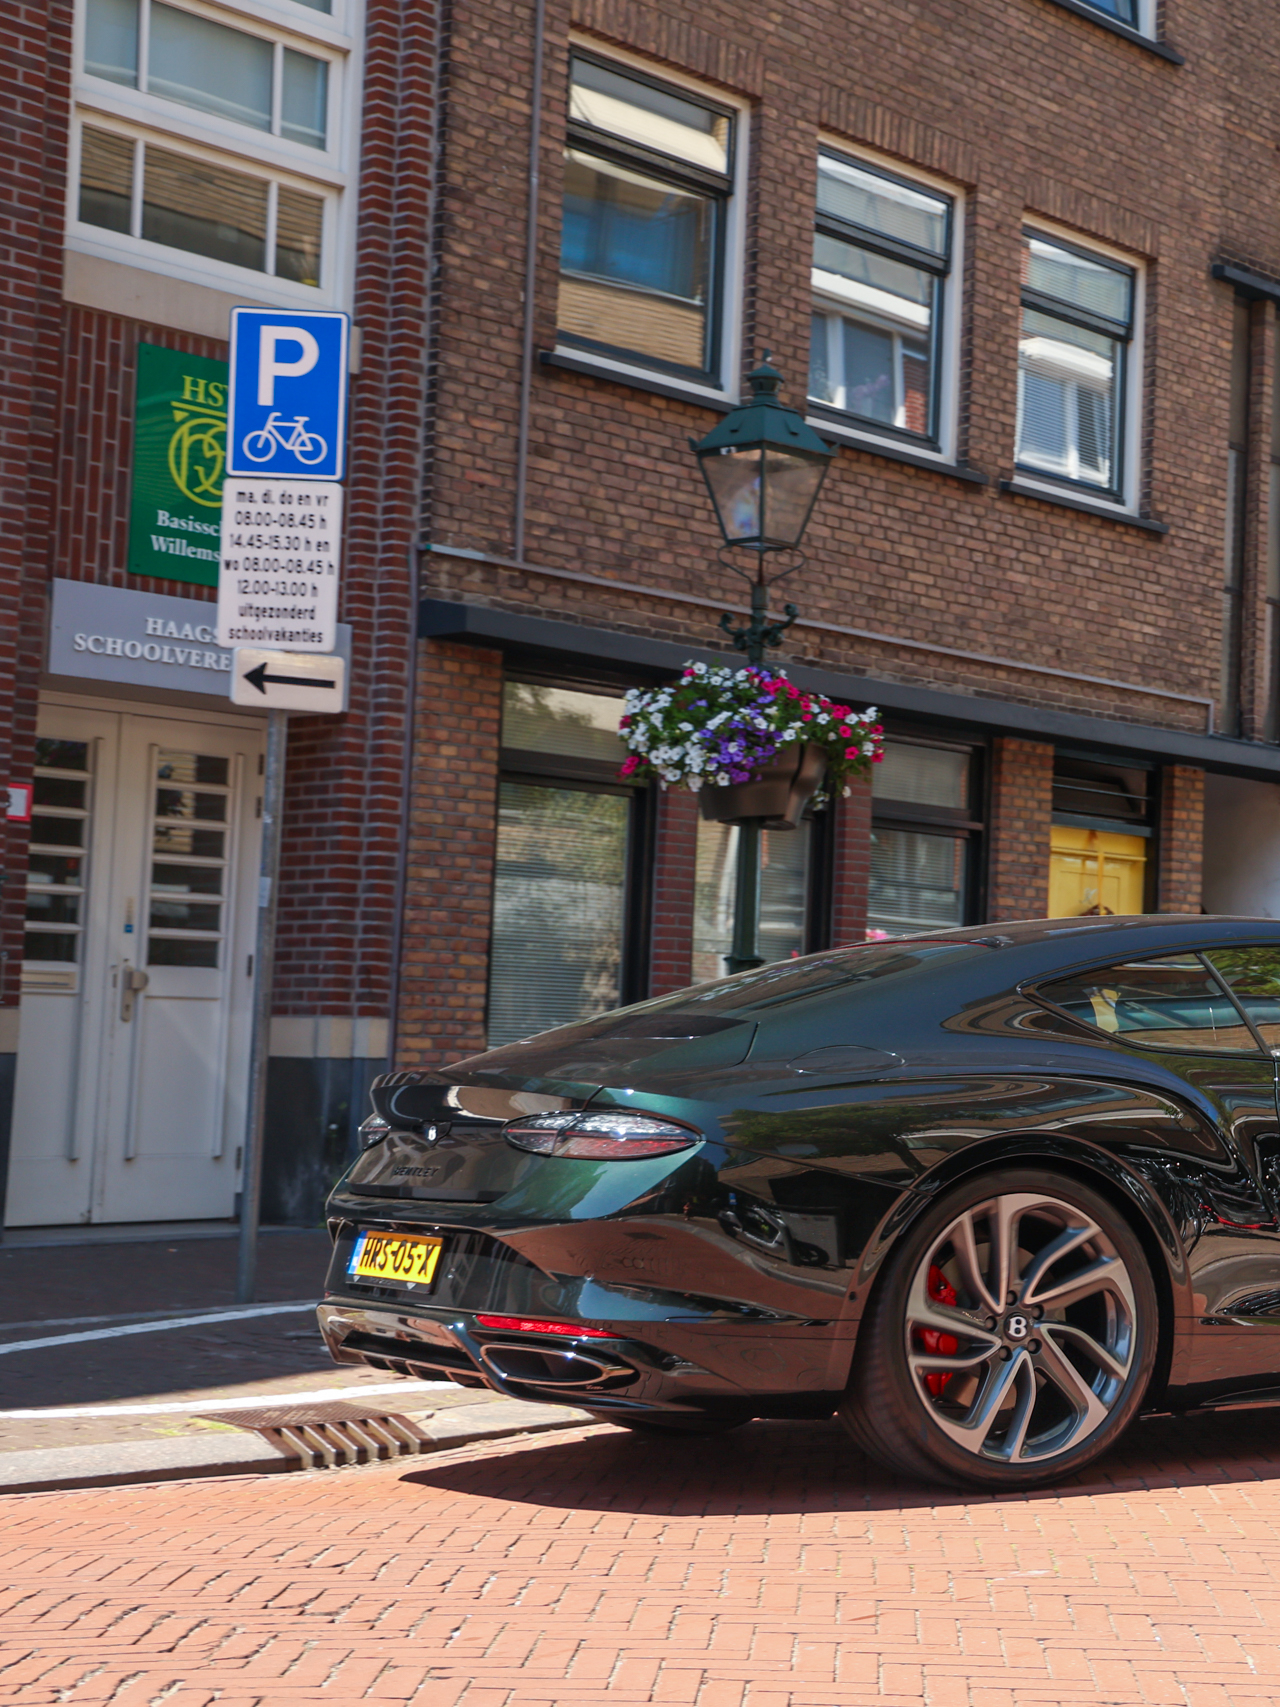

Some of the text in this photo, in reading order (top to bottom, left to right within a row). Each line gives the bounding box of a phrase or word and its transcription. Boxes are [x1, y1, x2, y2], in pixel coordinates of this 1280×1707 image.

[257, 325, 320, 406] P
[181, 375, 228, 407] HS
[279, 490, 294, 505] do
[297, 494, 312, 506] en
[316, 494, 329, 507] vr
[156, 509, 222, 537] Basissc
[235, 510, 327, 529] 08.00-08.45 h
[230, 533, 330, 552] 14.45-15.30 h en
[243, 556, 324, 575] 08.00-08.45
[327, 561, 335, 576] h
[237, 579, 318, 598] 12.00-13.00 h
[238, 602, 316, 622] uitgezonderd
[228, 625, 323, 643] schoolvakanties
[392, 1165, 441, 1177] BENTLEY
[359, 1236, 437, 1278] HRS-05-X
[1008, 1316, 1027, 1338] B
